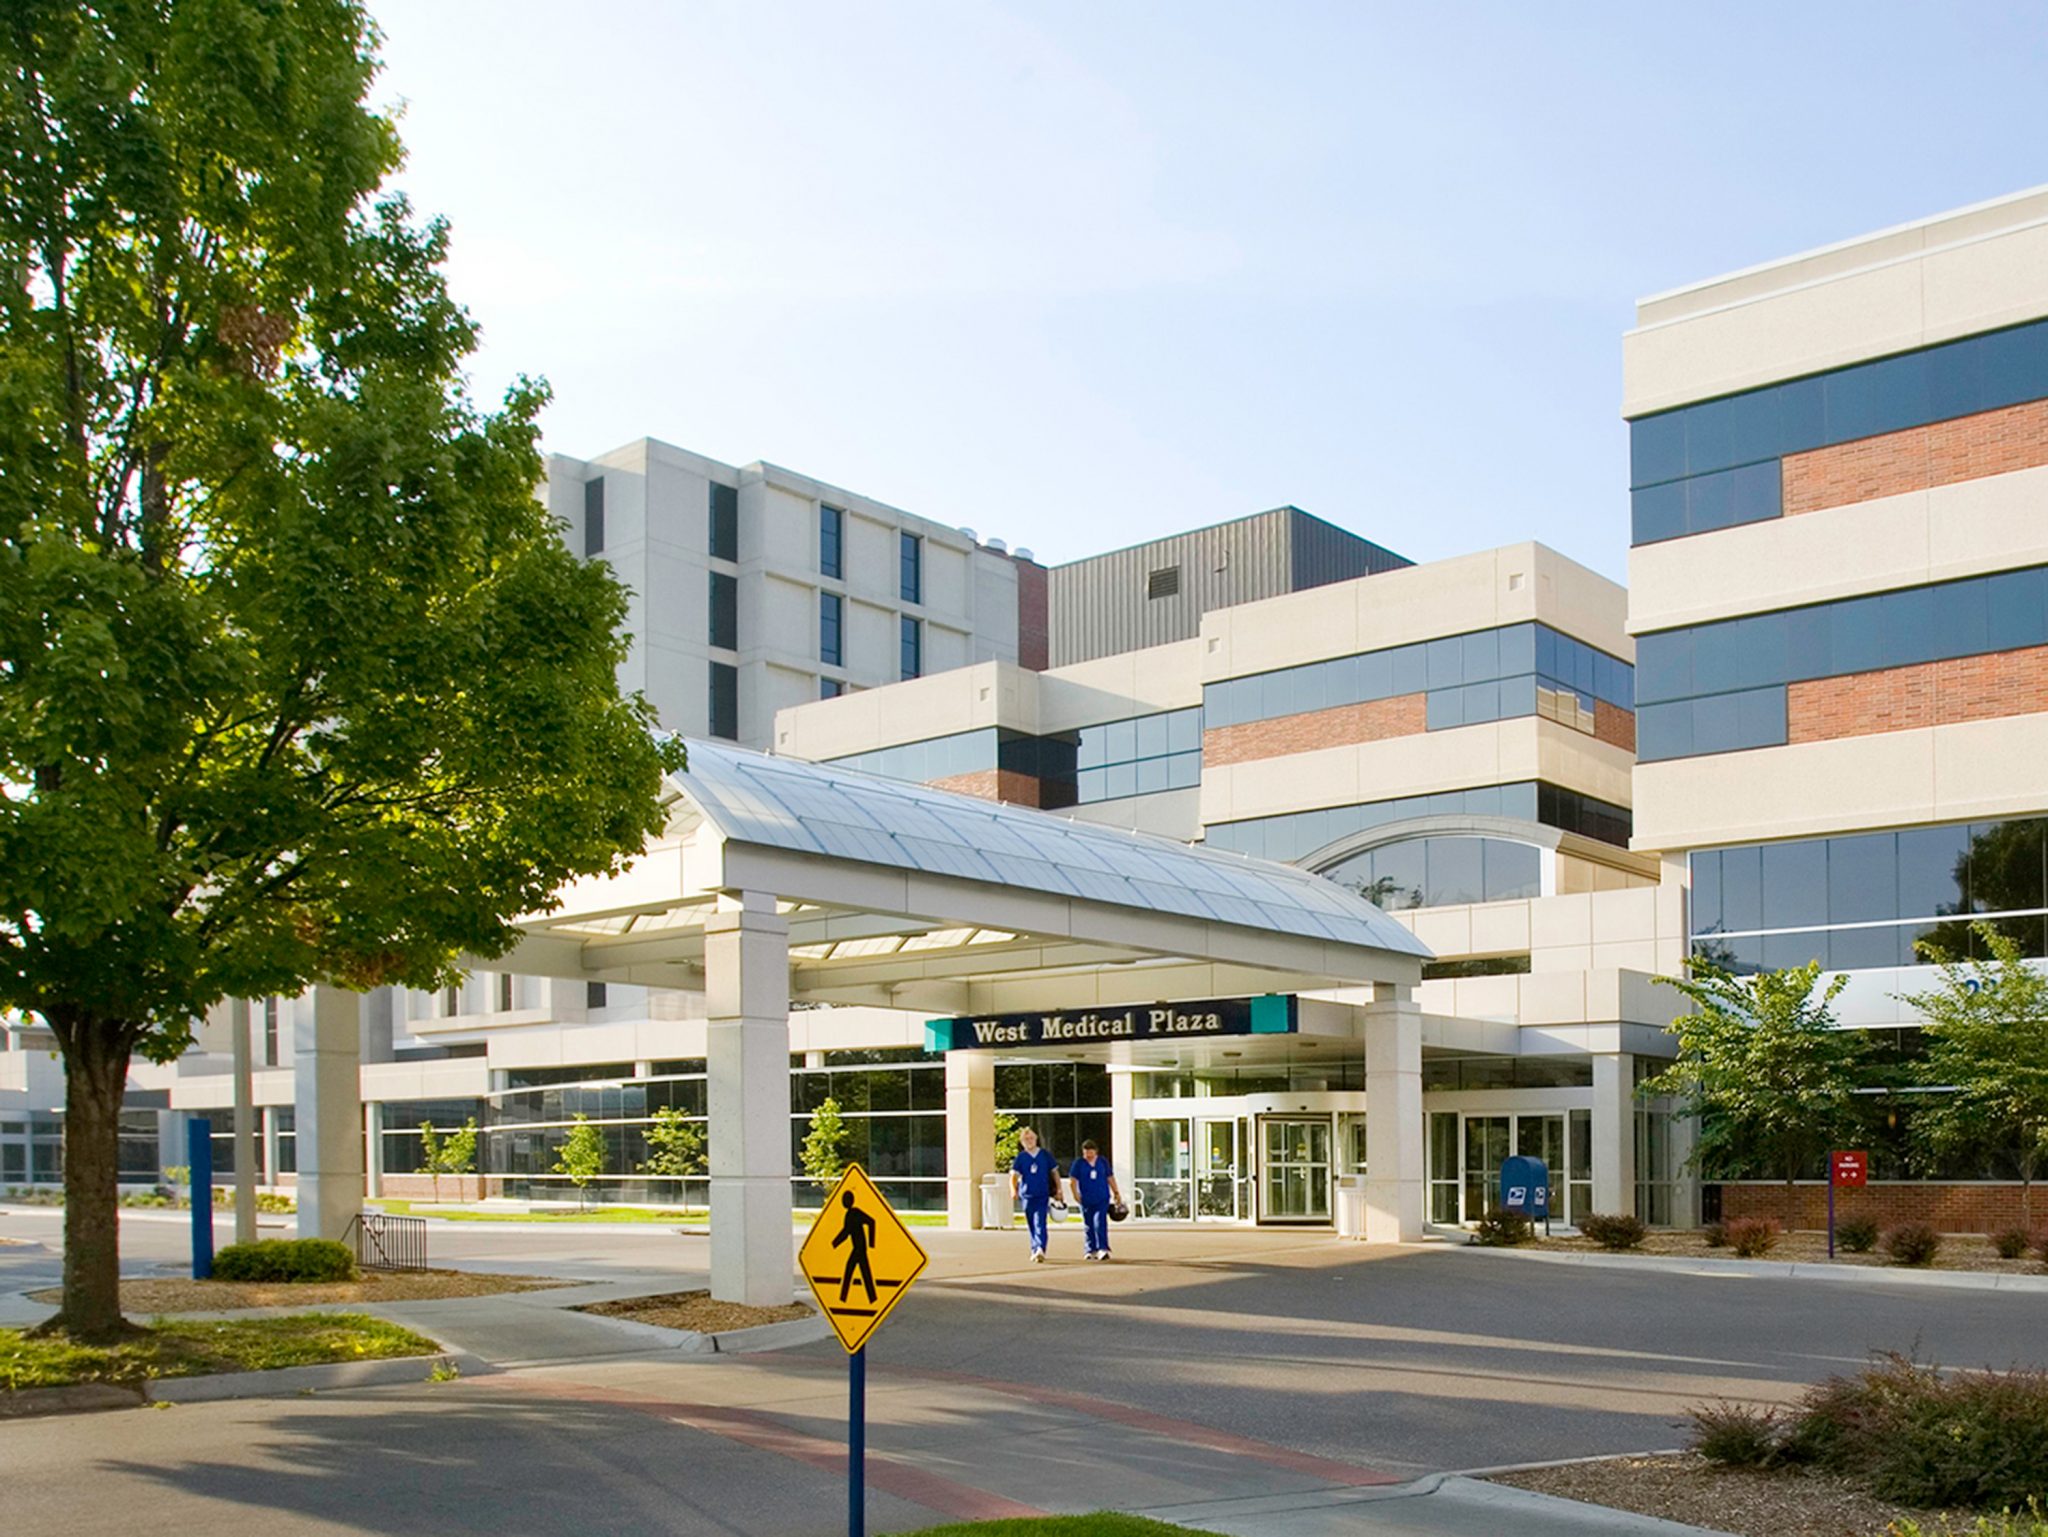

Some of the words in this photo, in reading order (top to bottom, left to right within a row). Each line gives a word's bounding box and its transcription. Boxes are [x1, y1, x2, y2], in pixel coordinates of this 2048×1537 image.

[972, 1021, 1028, 1043] West
[1041, 1012, 1133, 1040] Medical
[1148, 1009, 1219, 1033] Plaza
